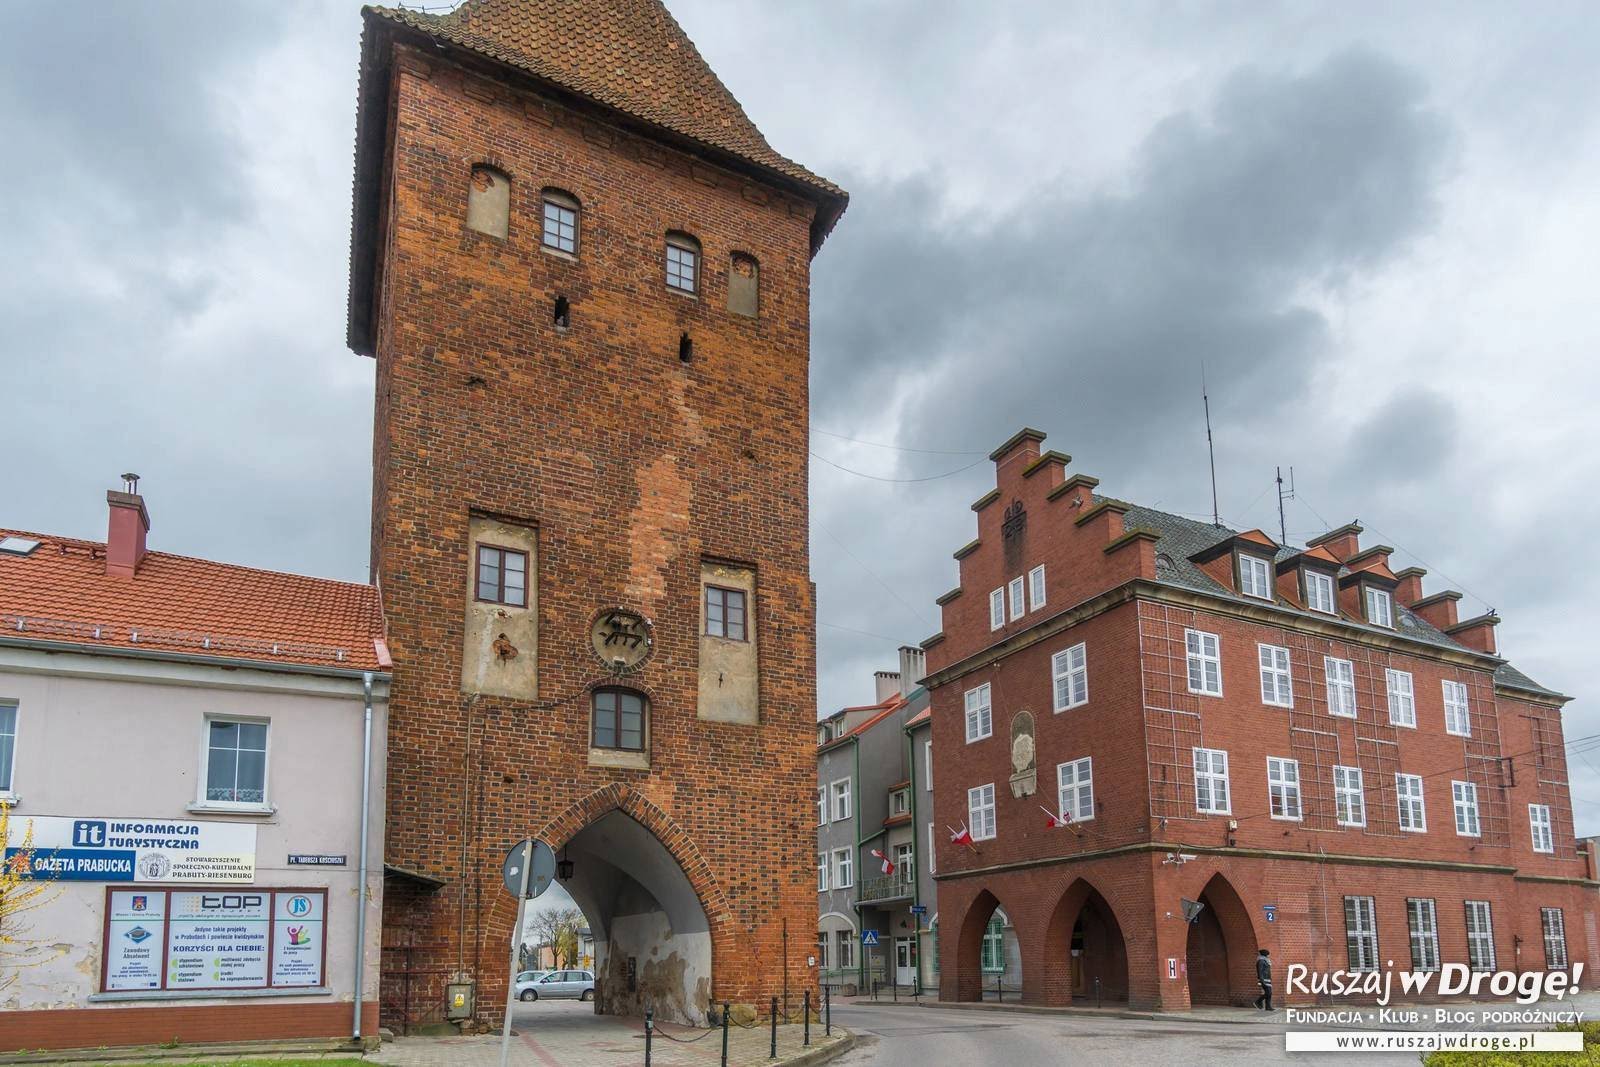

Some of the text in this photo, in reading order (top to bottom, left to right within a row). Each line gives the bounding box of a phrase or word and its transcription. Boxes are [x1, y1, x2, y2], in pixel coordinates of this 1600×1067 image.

[78, 823, 199, 844] it INFORMACJA
[108, 838, 199, 849] TURYSTYCZNA
[35, 857, 131, 872] GAZETA PRABUCKA
[172, 871, 252, 879] PRABUTY-RIESENBURG
[292, 898, 306, 913] JS
[1268, 912, 1273, 921] 2
[173, 944, 214, 952] KORZYŚCI
